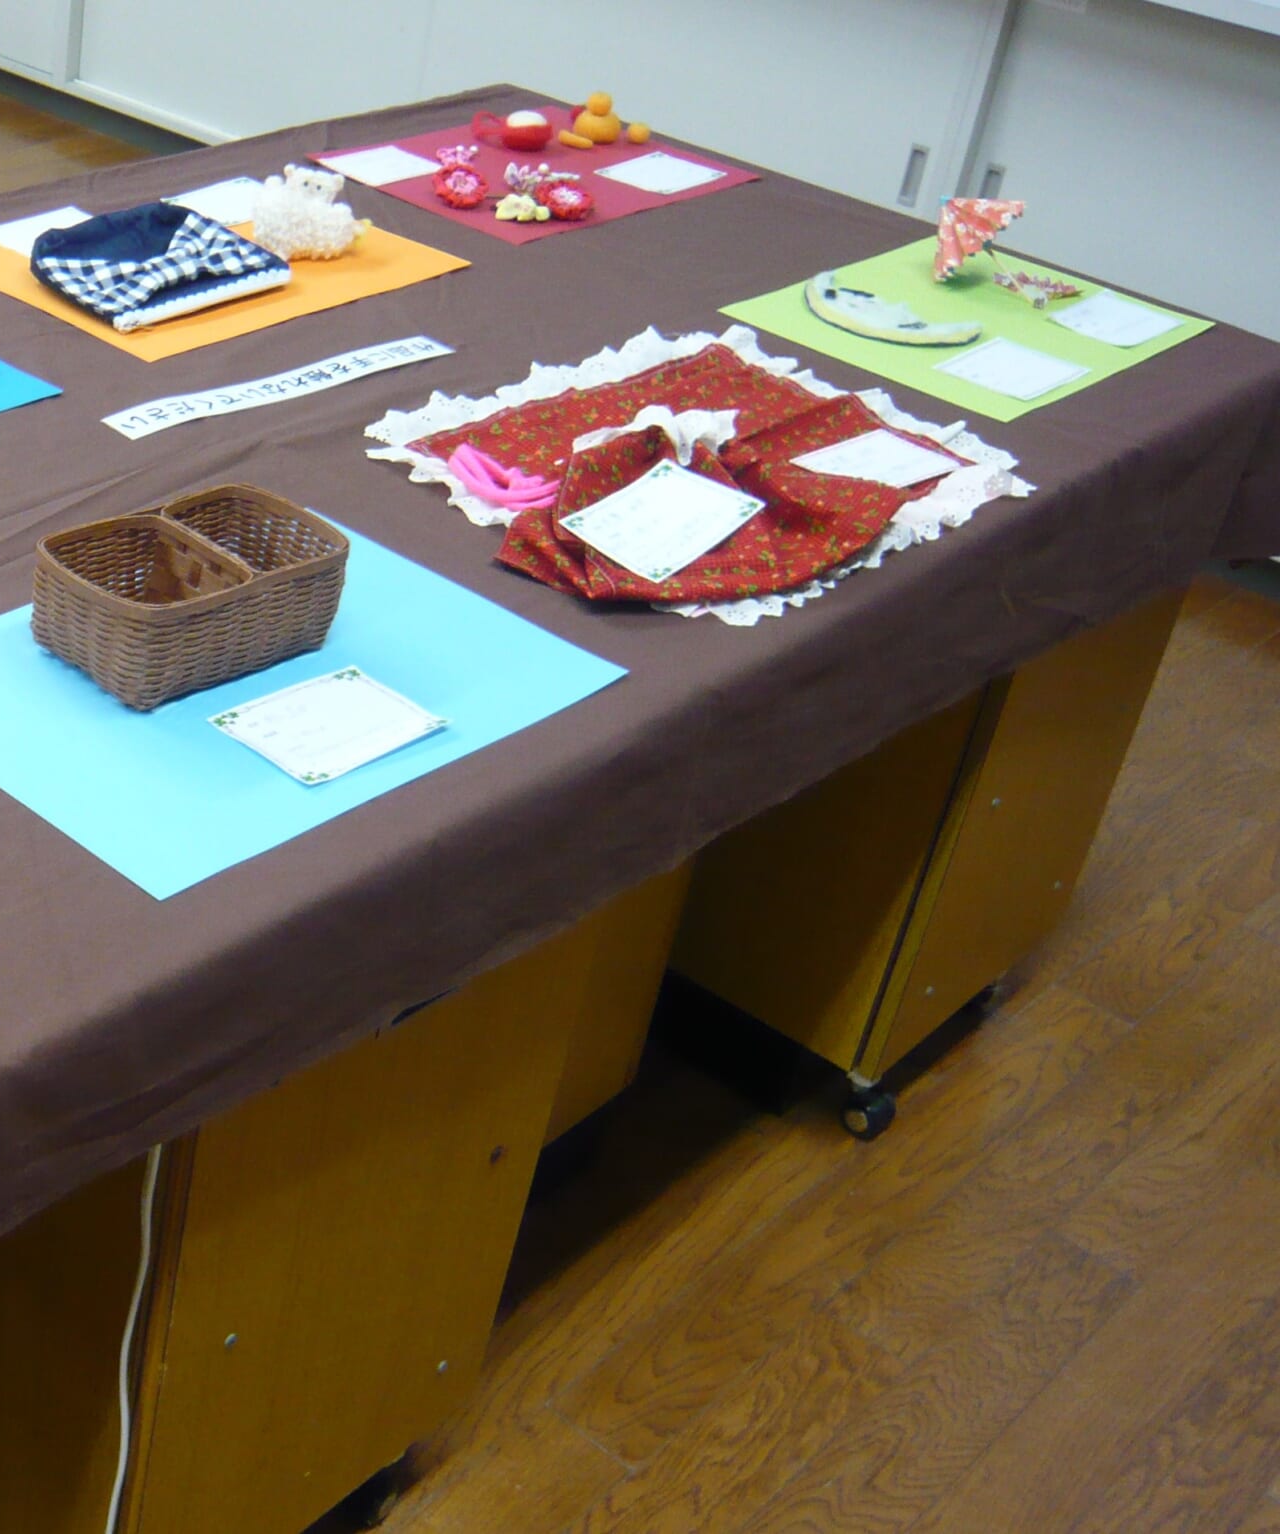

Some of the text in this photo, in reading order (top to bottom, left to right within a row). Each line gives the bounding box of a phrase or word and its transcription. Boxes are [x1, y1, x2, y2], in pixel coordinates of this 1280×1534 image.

[120, 342, 435, 430] 作品に手を触れないでください
